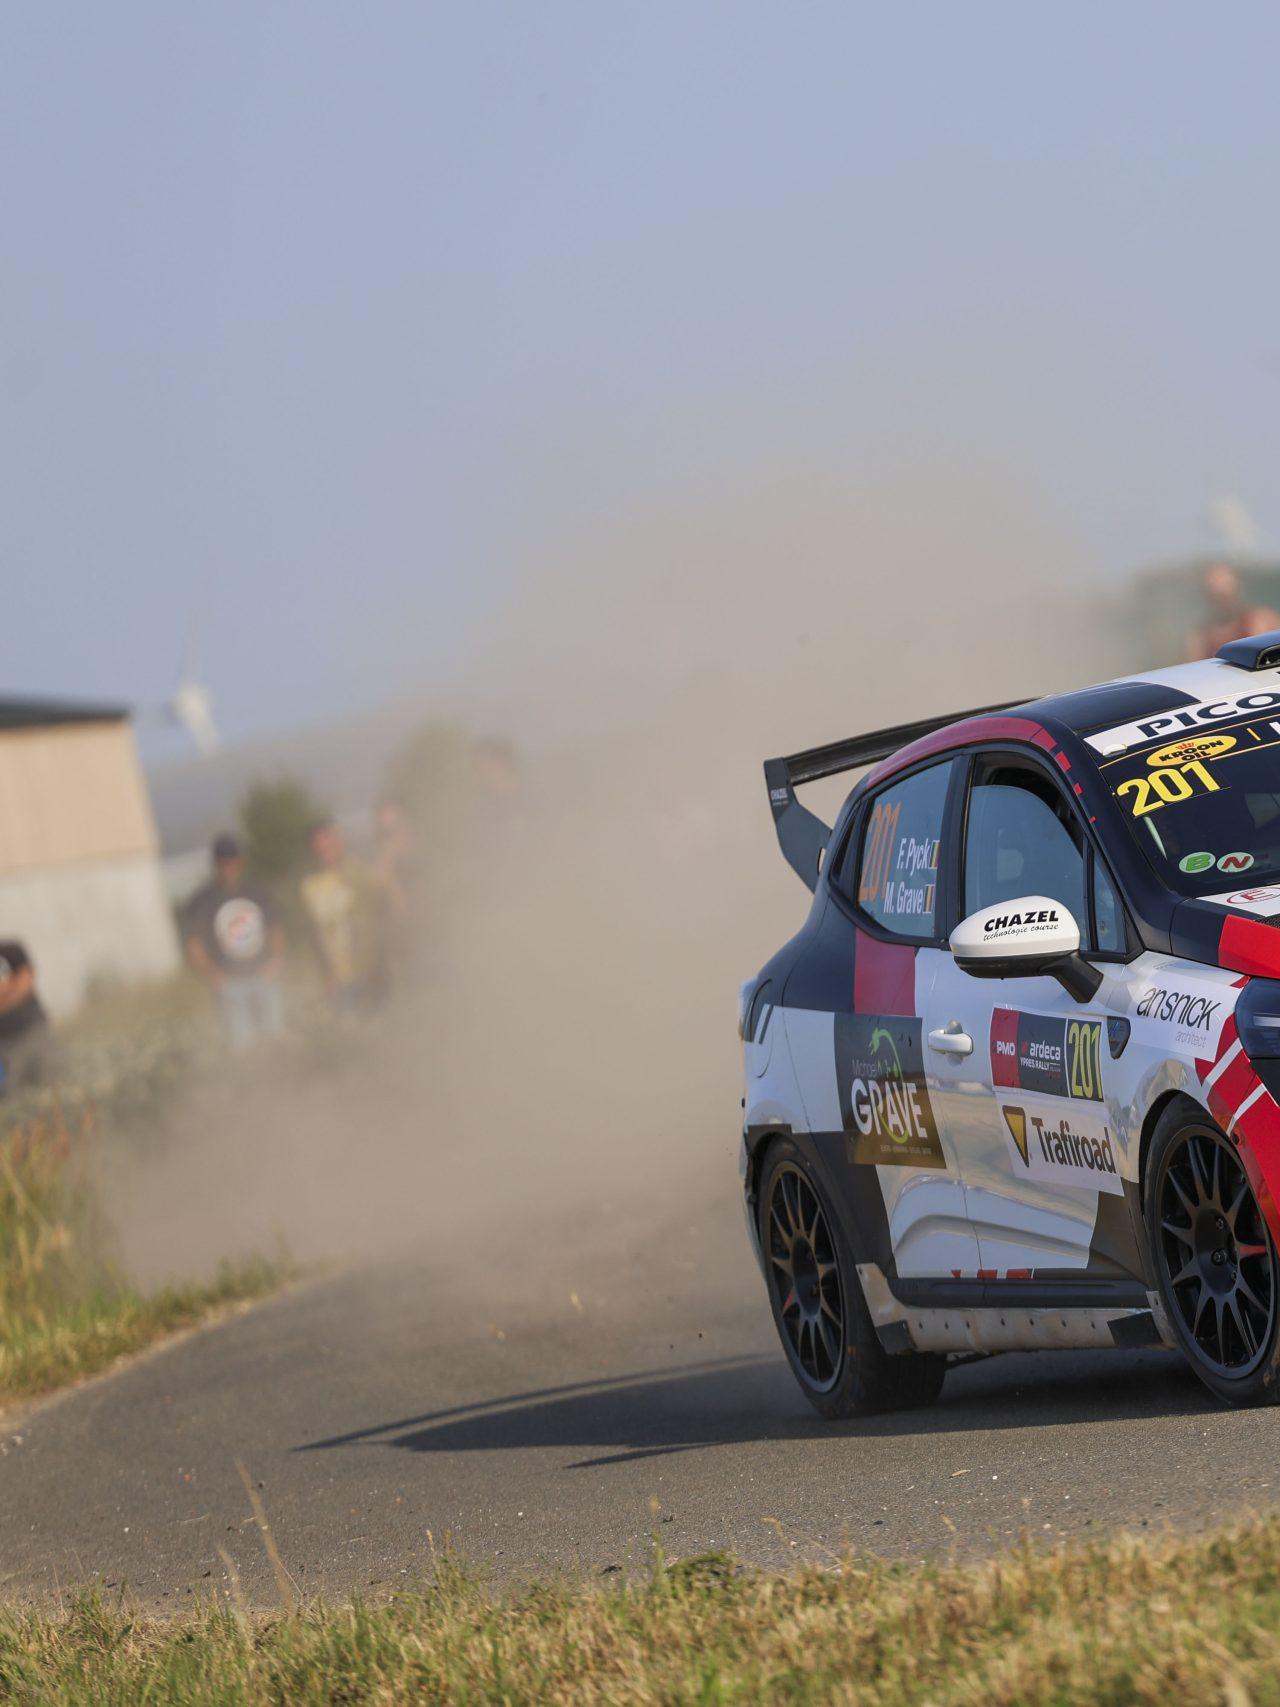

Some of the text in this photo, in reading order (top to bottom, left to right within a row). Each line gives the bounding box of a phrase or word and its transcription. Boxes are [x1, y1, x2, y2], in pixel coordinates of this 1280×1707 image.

[1159, 740, 1224, 762] KROON
[1182, 750, 1211, 761] OIL
[1117, 761, 1220, 817] 201
[859, 801, 901, 900] 201
[907, 838, 931, 876] Pyck
[897, 882, 923, 913] Grave
[984, 910, 1059, 932] CHAZEL
[984, 924, 1059, 941] technologie course
[997, 1040, 1060, 1060] PMO ardeca
[1069, 1022, 1102, 1099] 201
[852, 1078, 928, 1138] GRAVE
[1031, 1117, 1116, 1174] Trafiroad
